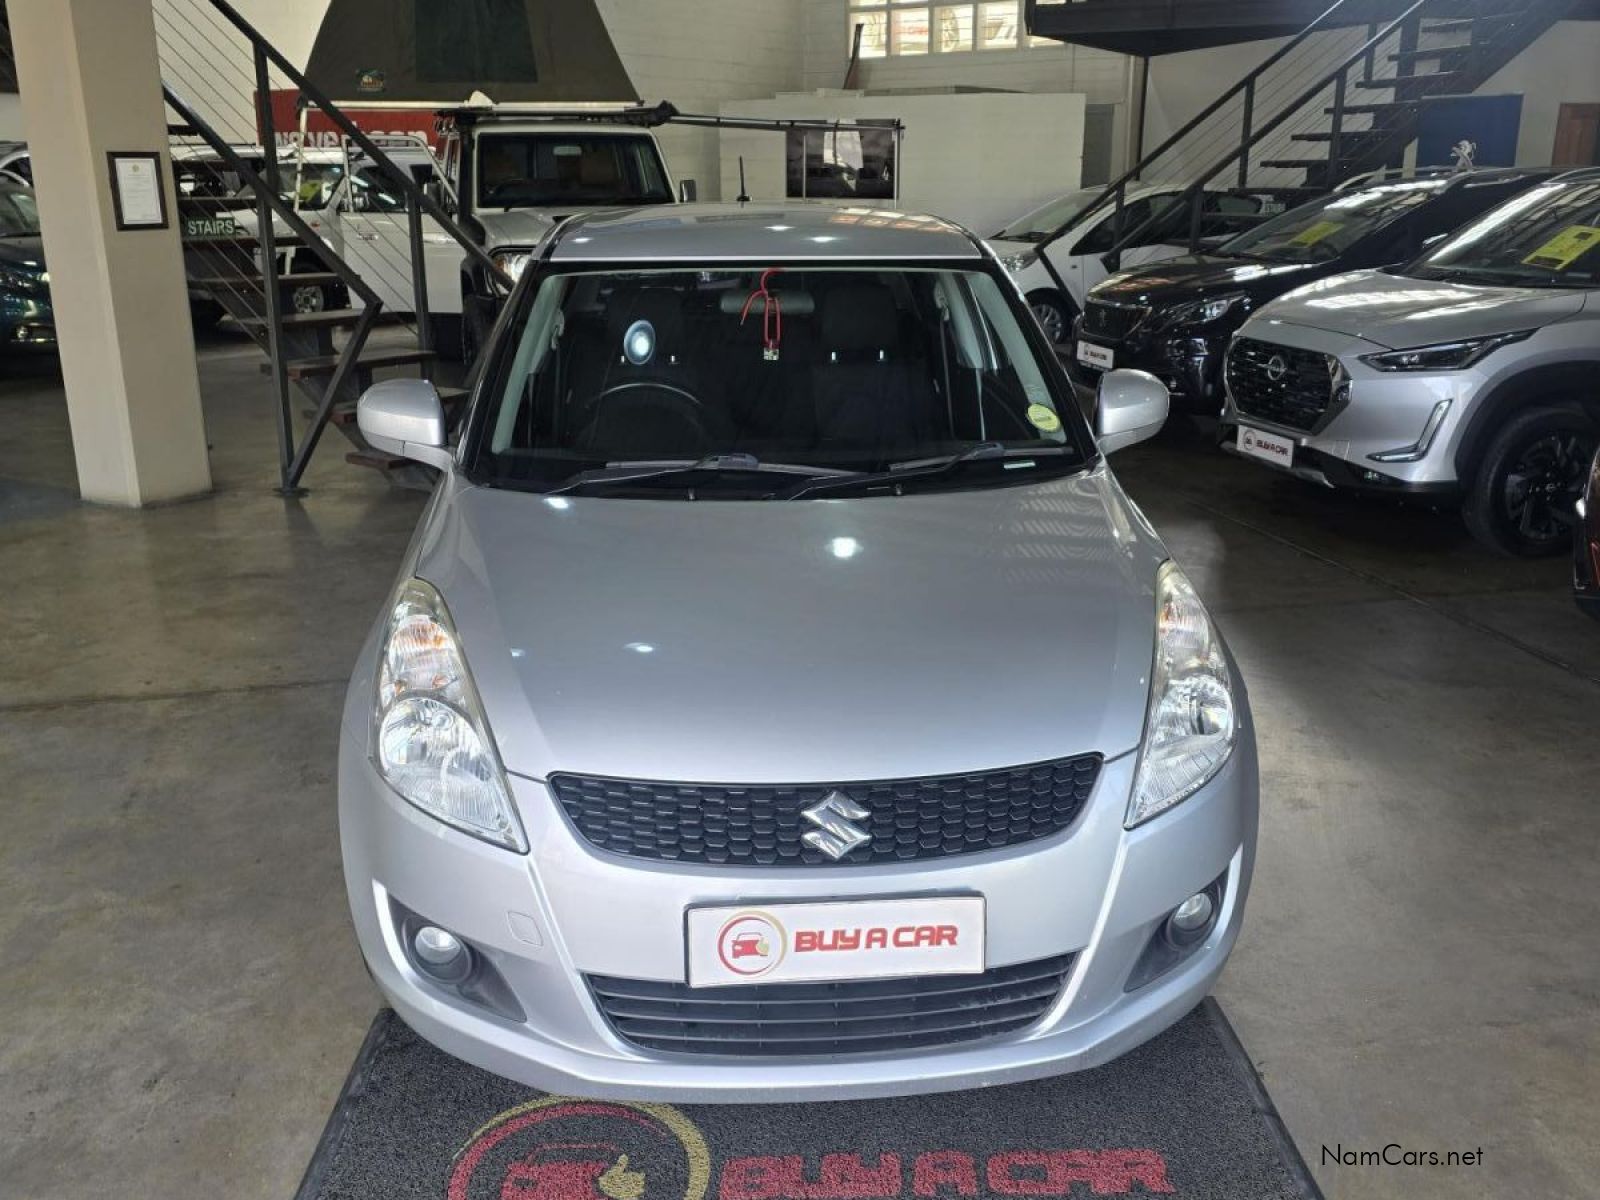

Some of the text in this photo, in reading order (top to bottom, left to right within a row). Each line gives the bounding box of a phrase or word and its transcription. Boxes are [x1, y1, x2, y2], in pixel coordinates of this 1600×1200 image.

[187, 219, 234, 236] STAIRS
[794, 924, 959, 952] BUY A CAR
[719, 1149, 1178, 1200] BUY A CAR
